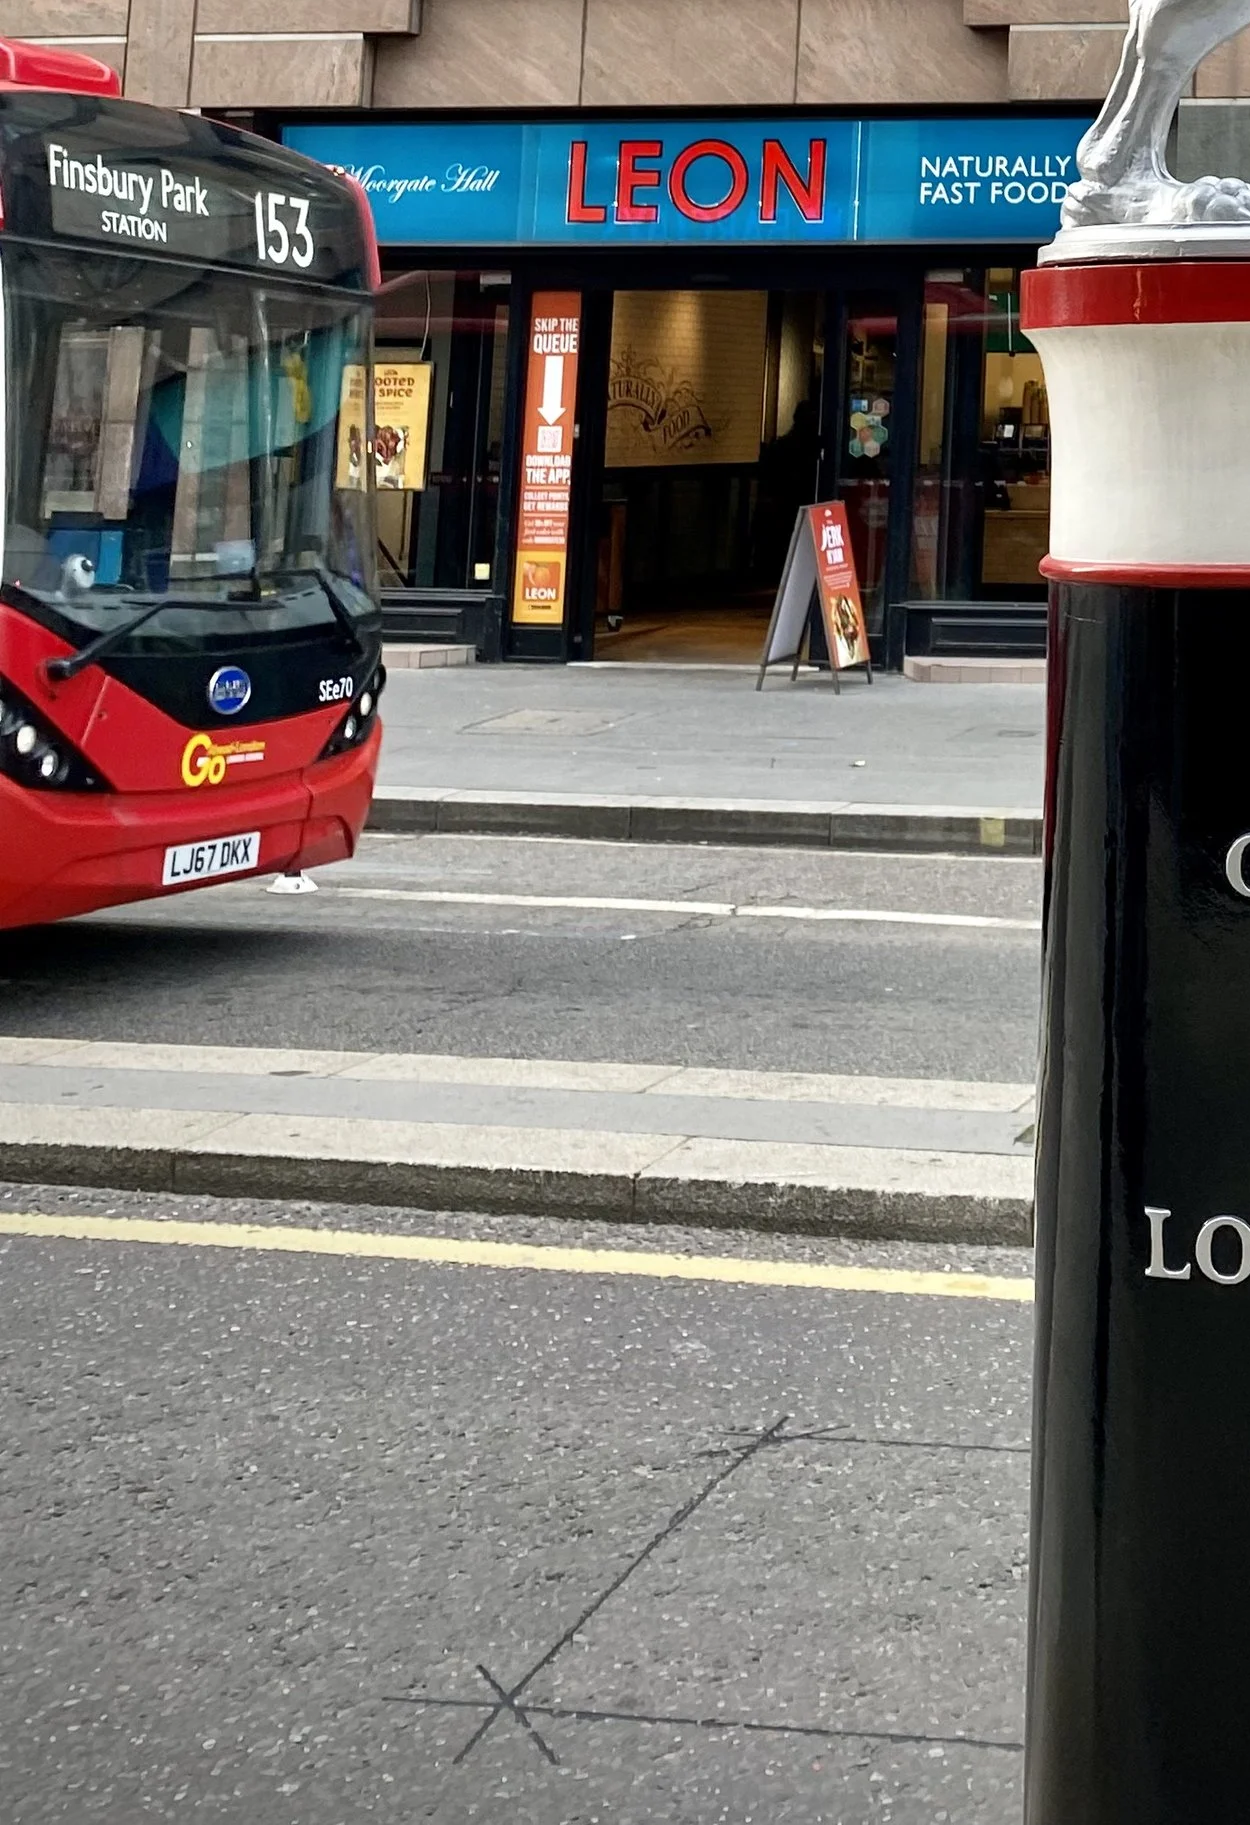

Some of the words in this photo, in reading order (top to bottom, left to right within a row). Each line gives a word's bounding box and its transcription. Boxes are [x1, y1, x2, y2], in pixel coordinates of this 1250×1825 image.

[49, 143, 153, 215] Finsbury
[160, 168, 210, 217] Park
[441, 162, 501, 193] Hall
[920, 155, 1072, 178] NATURALLY
[565, 137, 827, 224] LEON
[919, 181, 976, 205] FAST
[990, 180, 1069, 205] FOOD
[101, 210, 168, 243] STATION
[254, 191, 314, 268] 153
[534, 317, 559, 333] SKIP
[559, 317, 580, 333] THE
[533, 333, 579, 355] QUEUE
[374, 377, 415, 387] OOTED
[608, 378, 659, 414] TURALLY
[525, 454, 571, 467] DOWNLOAD
[525, 467, 547, 485] THE
[525, 587, 557, 601] LEON
[318, 676, 354, 703] SEe70
[181, 732, 227, 787] Go
[170, 843, 218, 878] LJ67
[220, 836, 252, 868] DKX
